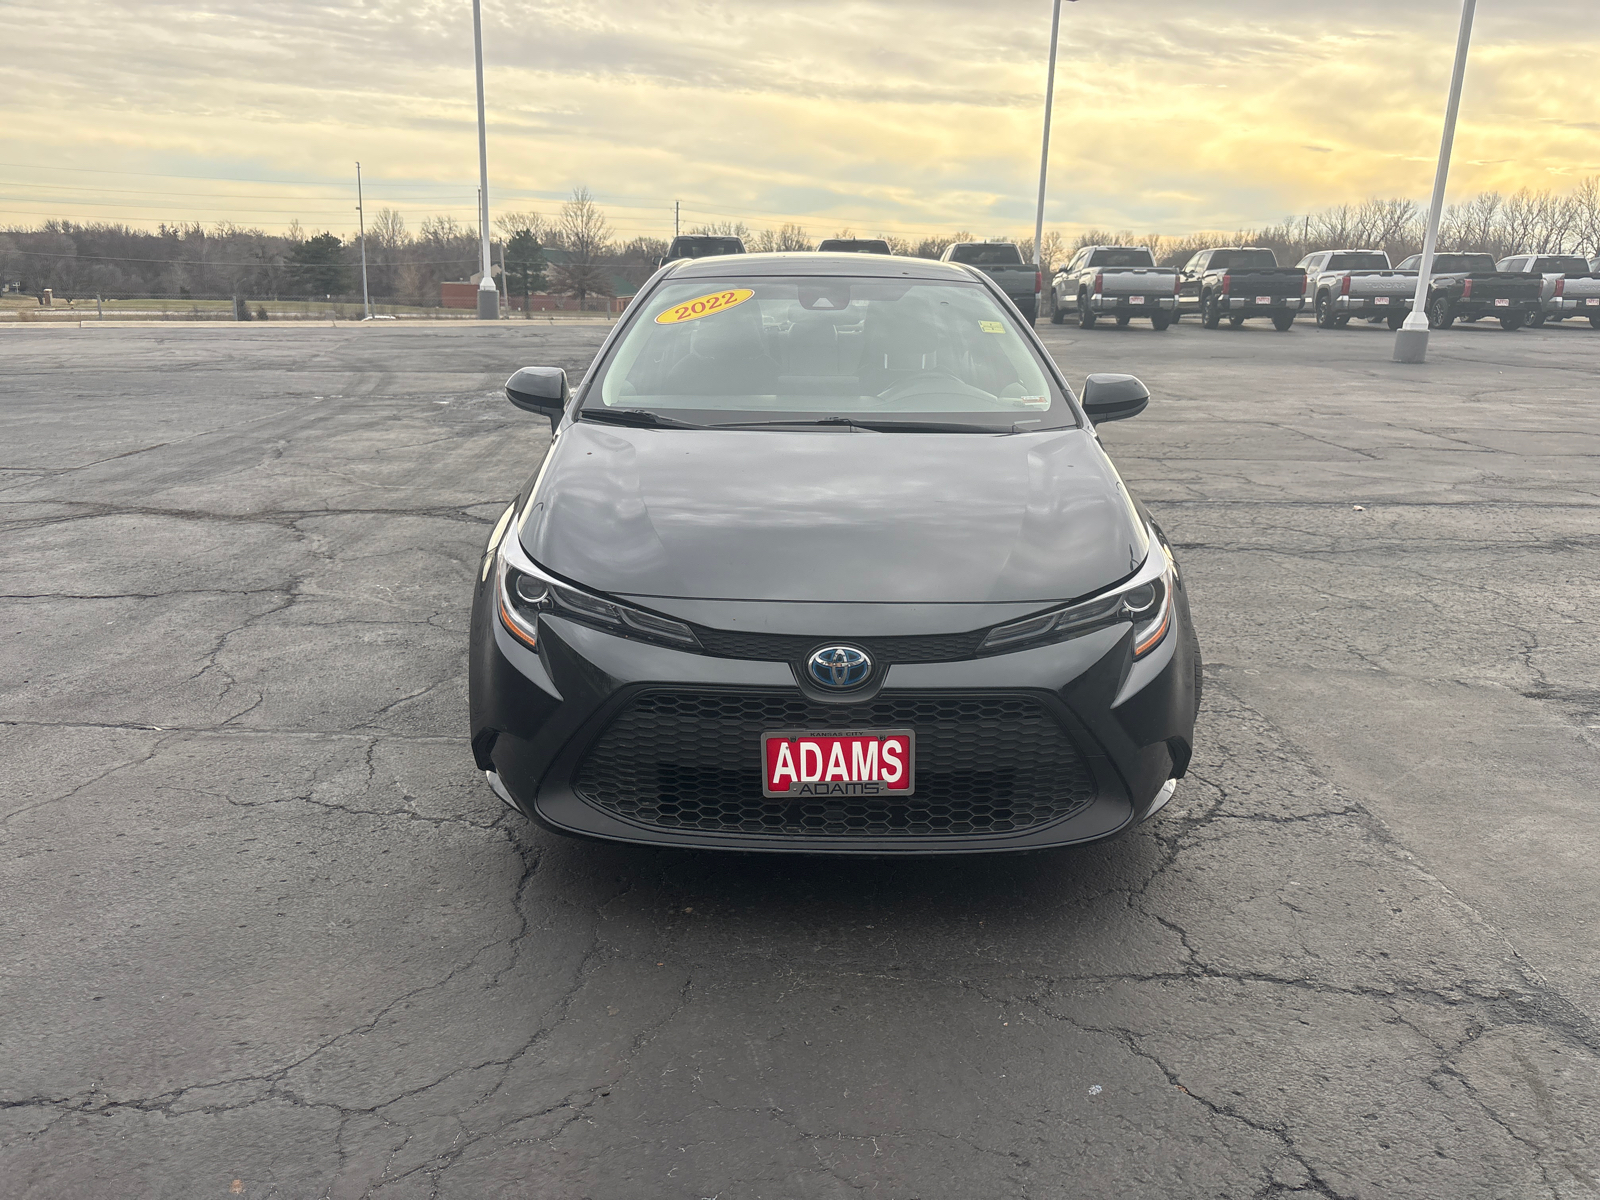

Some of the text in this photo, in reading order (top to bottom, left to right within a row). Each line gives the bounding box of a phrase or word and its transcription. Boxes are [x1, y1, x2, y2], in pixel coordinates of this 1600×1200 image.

[1365, 281, 1406, 289] TUNDRA
[674, 292, 737, 320] 2022
[772, 739, 903, 783] ADAMS
[799, 782, 880, 796] ADAMS
